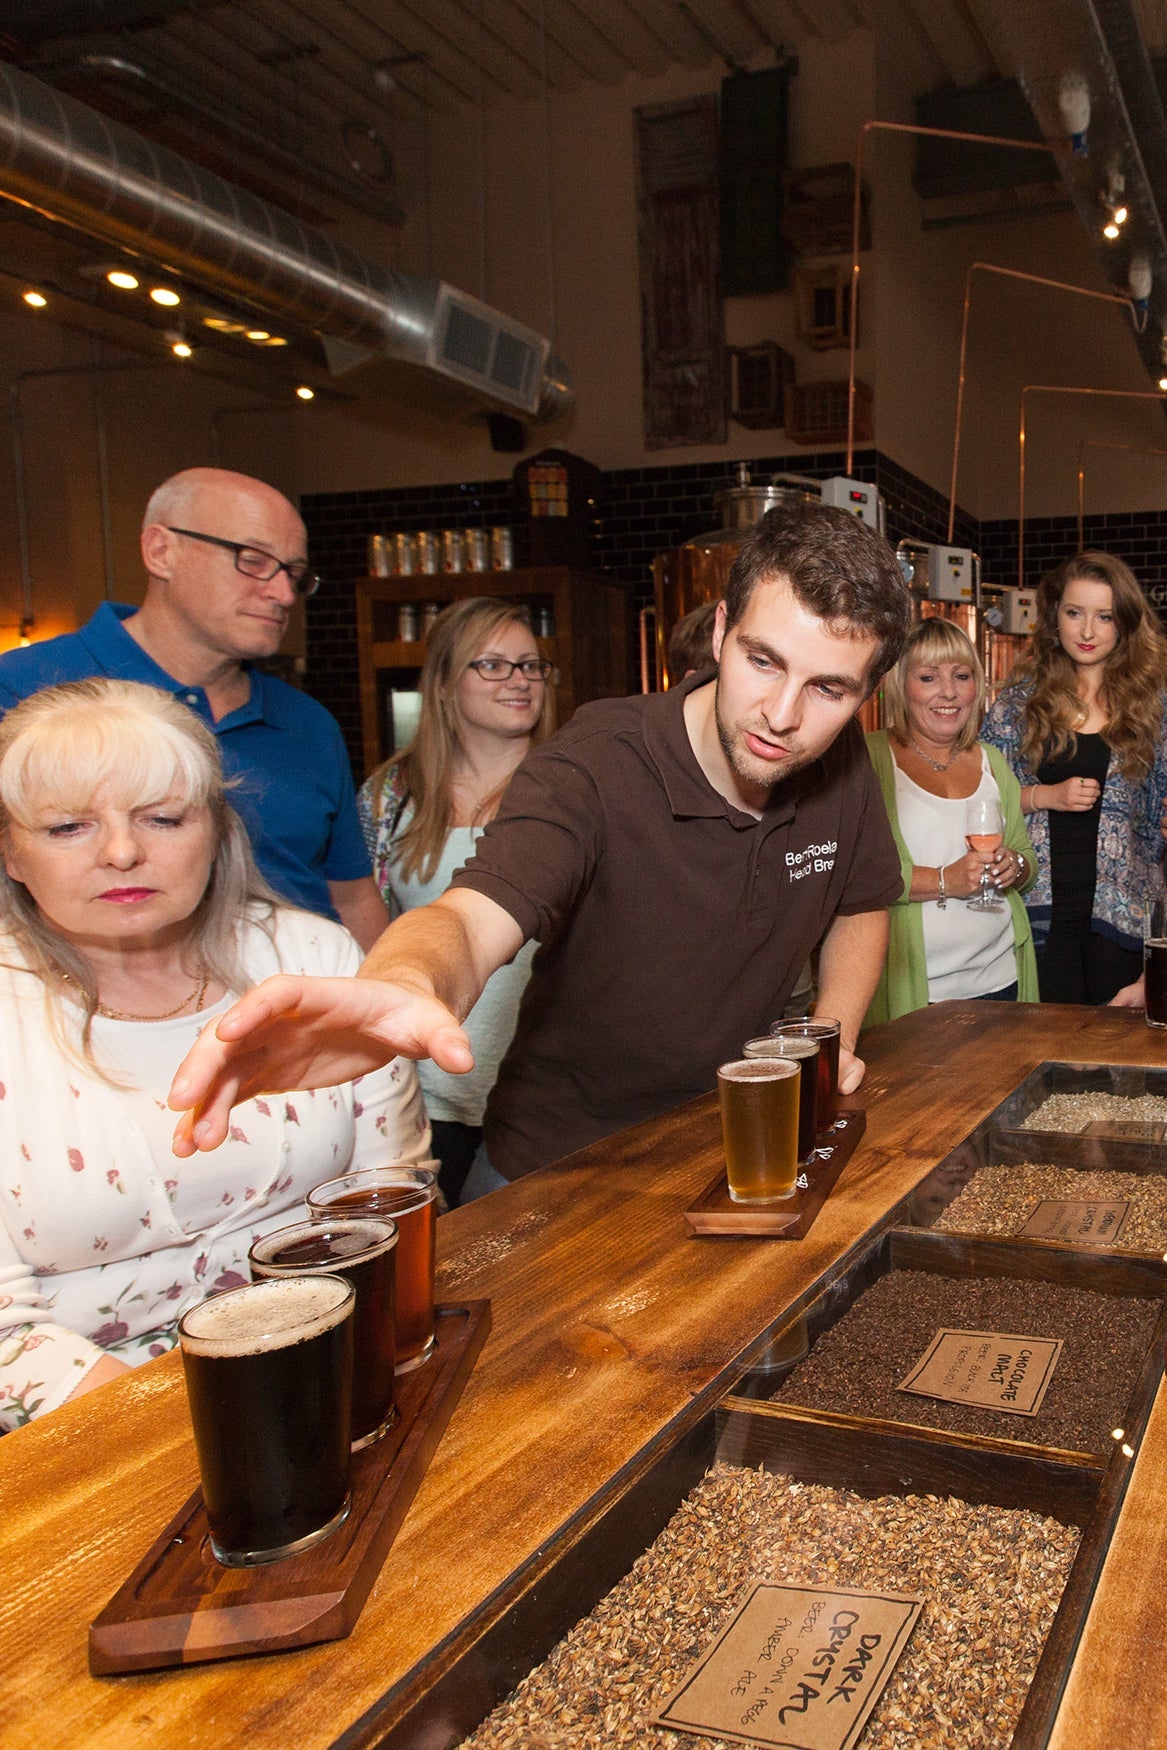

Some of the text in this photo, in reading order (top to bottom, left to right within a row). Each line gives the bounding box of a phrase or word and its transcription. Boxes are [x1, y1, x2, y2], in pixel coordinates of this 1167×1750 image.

[988, 1353, 1012, 1385] MALT
[1000, 1349, 1033, 1401] CHOCOLATE
[797, 1601, 826, 1638] BEER:
[730, 1616, 793, 1697] AMBER ALE
[778, 1610, 860, 1726] CRYSTAL
[826, 1633, 882, 1705] DARK
[759, 1686, 775, 1696] A
